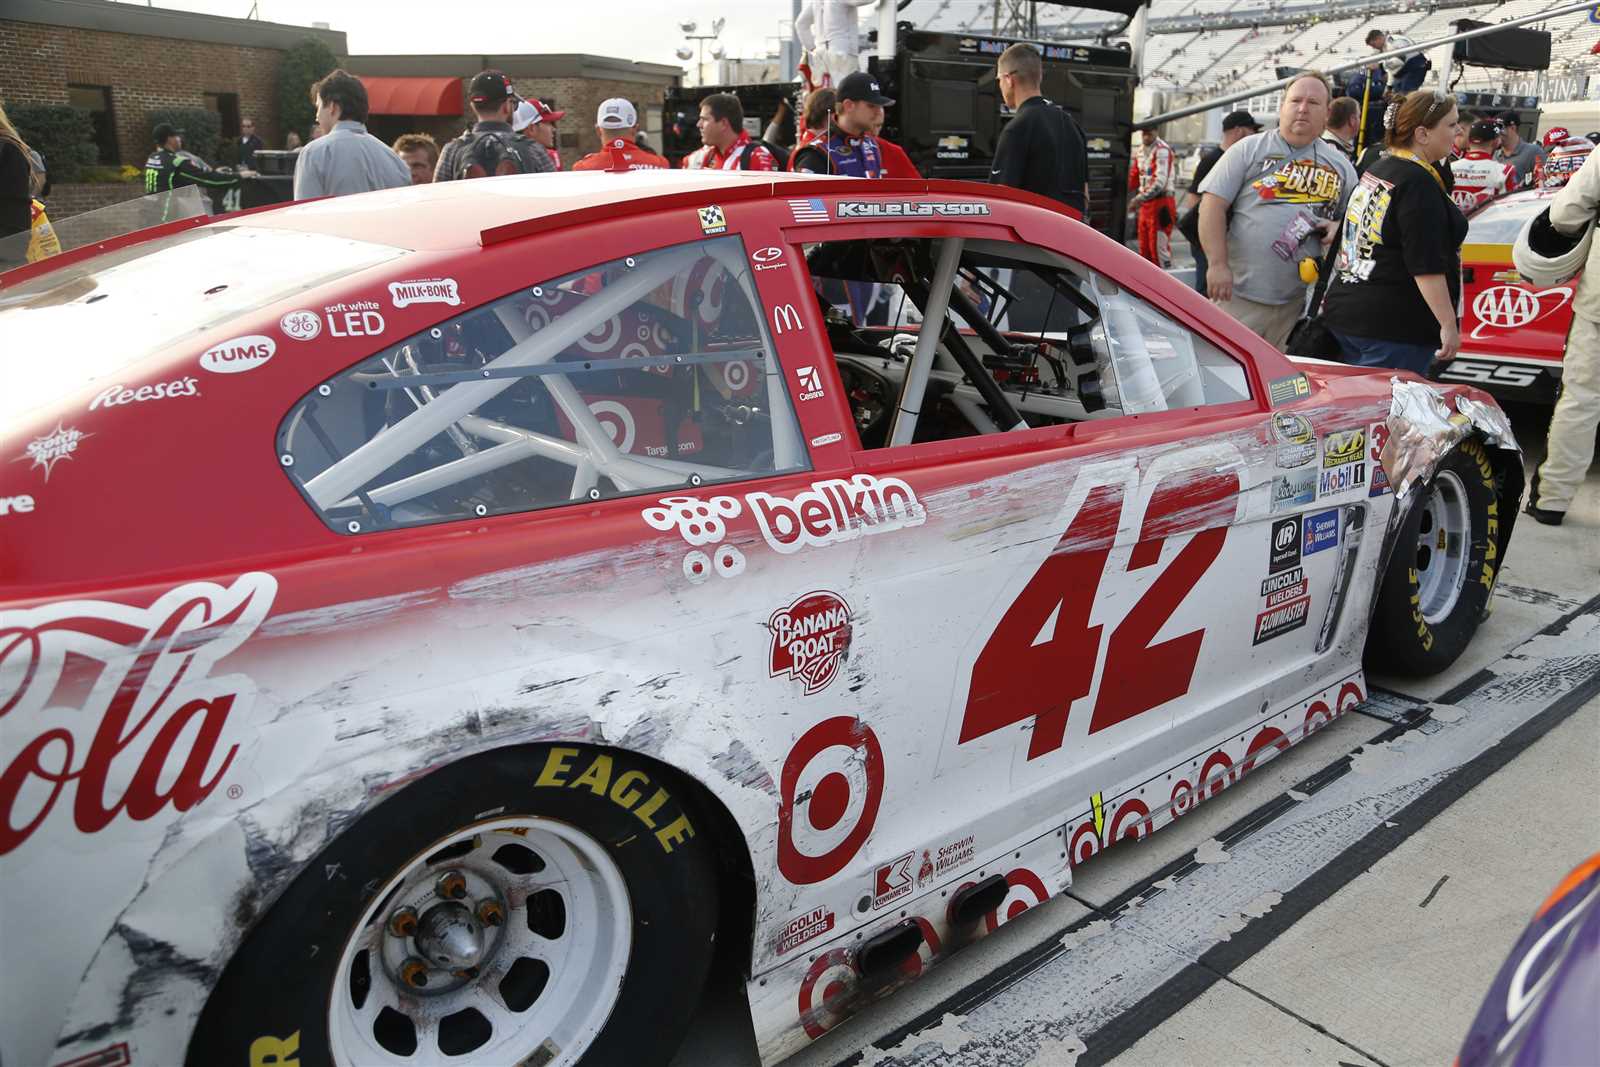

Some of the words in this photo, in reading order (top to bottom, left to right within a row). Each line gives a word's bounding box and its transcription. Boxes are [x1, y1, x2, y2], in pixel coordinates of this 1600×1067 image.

[222, 188, 241, 211] 41
[325, 303, 347, 314] soft
[349, 301, 380, 312] white
[1479, 288, 1532, 326] AAA
[326, 310, 386, 338] LED
[209, 343, 271, 363] TUMS
[1438, 361, 1544, 387] SS
[88, 376, 199, 411] Reese's
[799, 389, 825, 401] Cessna
[1320, 465, 1351, 493] Mobil
[751, 477, 921, 549] belkin
[1315, 519, 1336, 533] SHERWIN
[1314, 529, 1336, 543] WILLIAMS
[1262, 569, 1301, 596] LINCOLN
[1269, 584, 1303, 606] WELDERS
[957, 462, 1242, 762] 42
[1256, 602, 1307, 641] FLOWMASTER
[772, 607, 850, 648] BANANA
[789, 632, 837, 672] BOAT
[534, 747, 696, 854] EAGLE
[936, 847, 974, 872] WILLIAMS
[937, 834, 975, 860] SHERWIN
[771, 909, 823, 942] INCOLN
[783, 921, 828, 951] WELDERS
